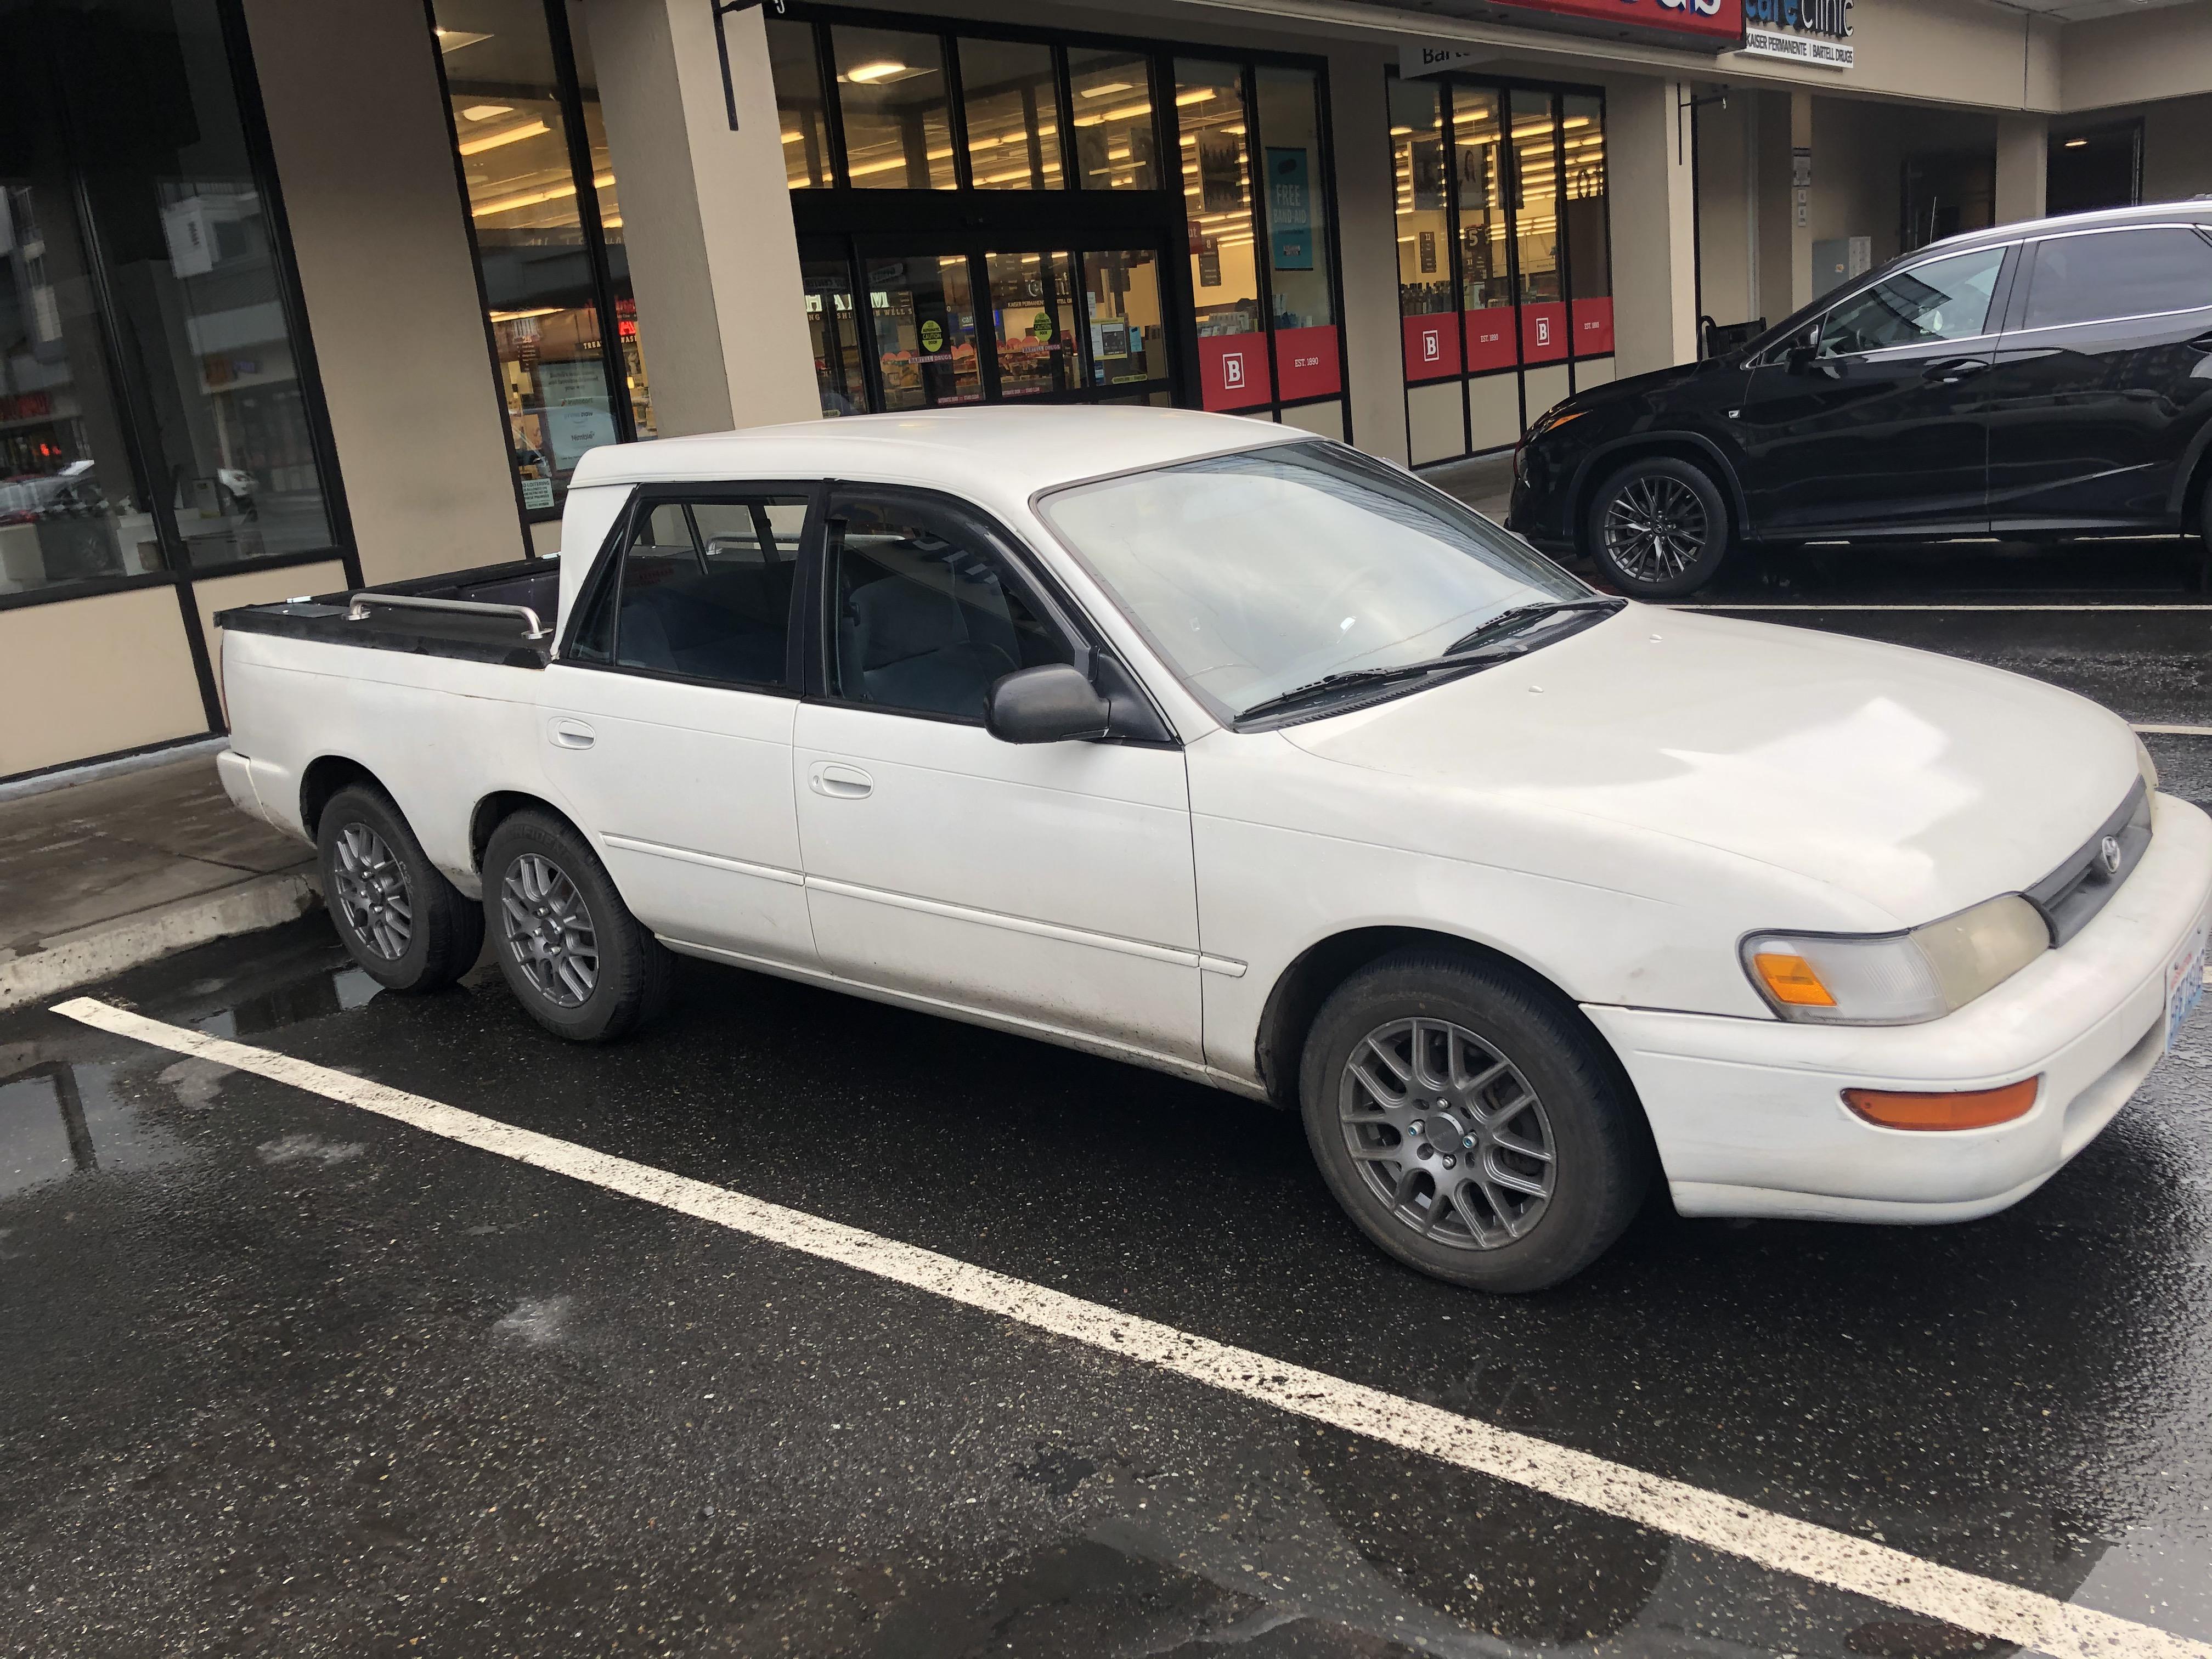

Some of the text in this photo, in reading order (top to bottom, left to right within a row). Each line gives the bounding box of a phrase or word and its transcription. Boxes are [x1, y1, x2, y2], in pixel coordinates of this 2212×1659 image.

[1746, 32, 1853, 64] KAISER PERMANENTE BARTELL DRUGS
[1276, 184, 1301, 206] FREE
[1469, 229, 1479, 246] 5
[1538, 323, 1547, 341] B
[583, 340, 602, 350] TREA
[1426, 336, 1436, 356] B
[1227, 360, 1241, 382] B
[1295, 357, 1319, 368] EST. 1890
